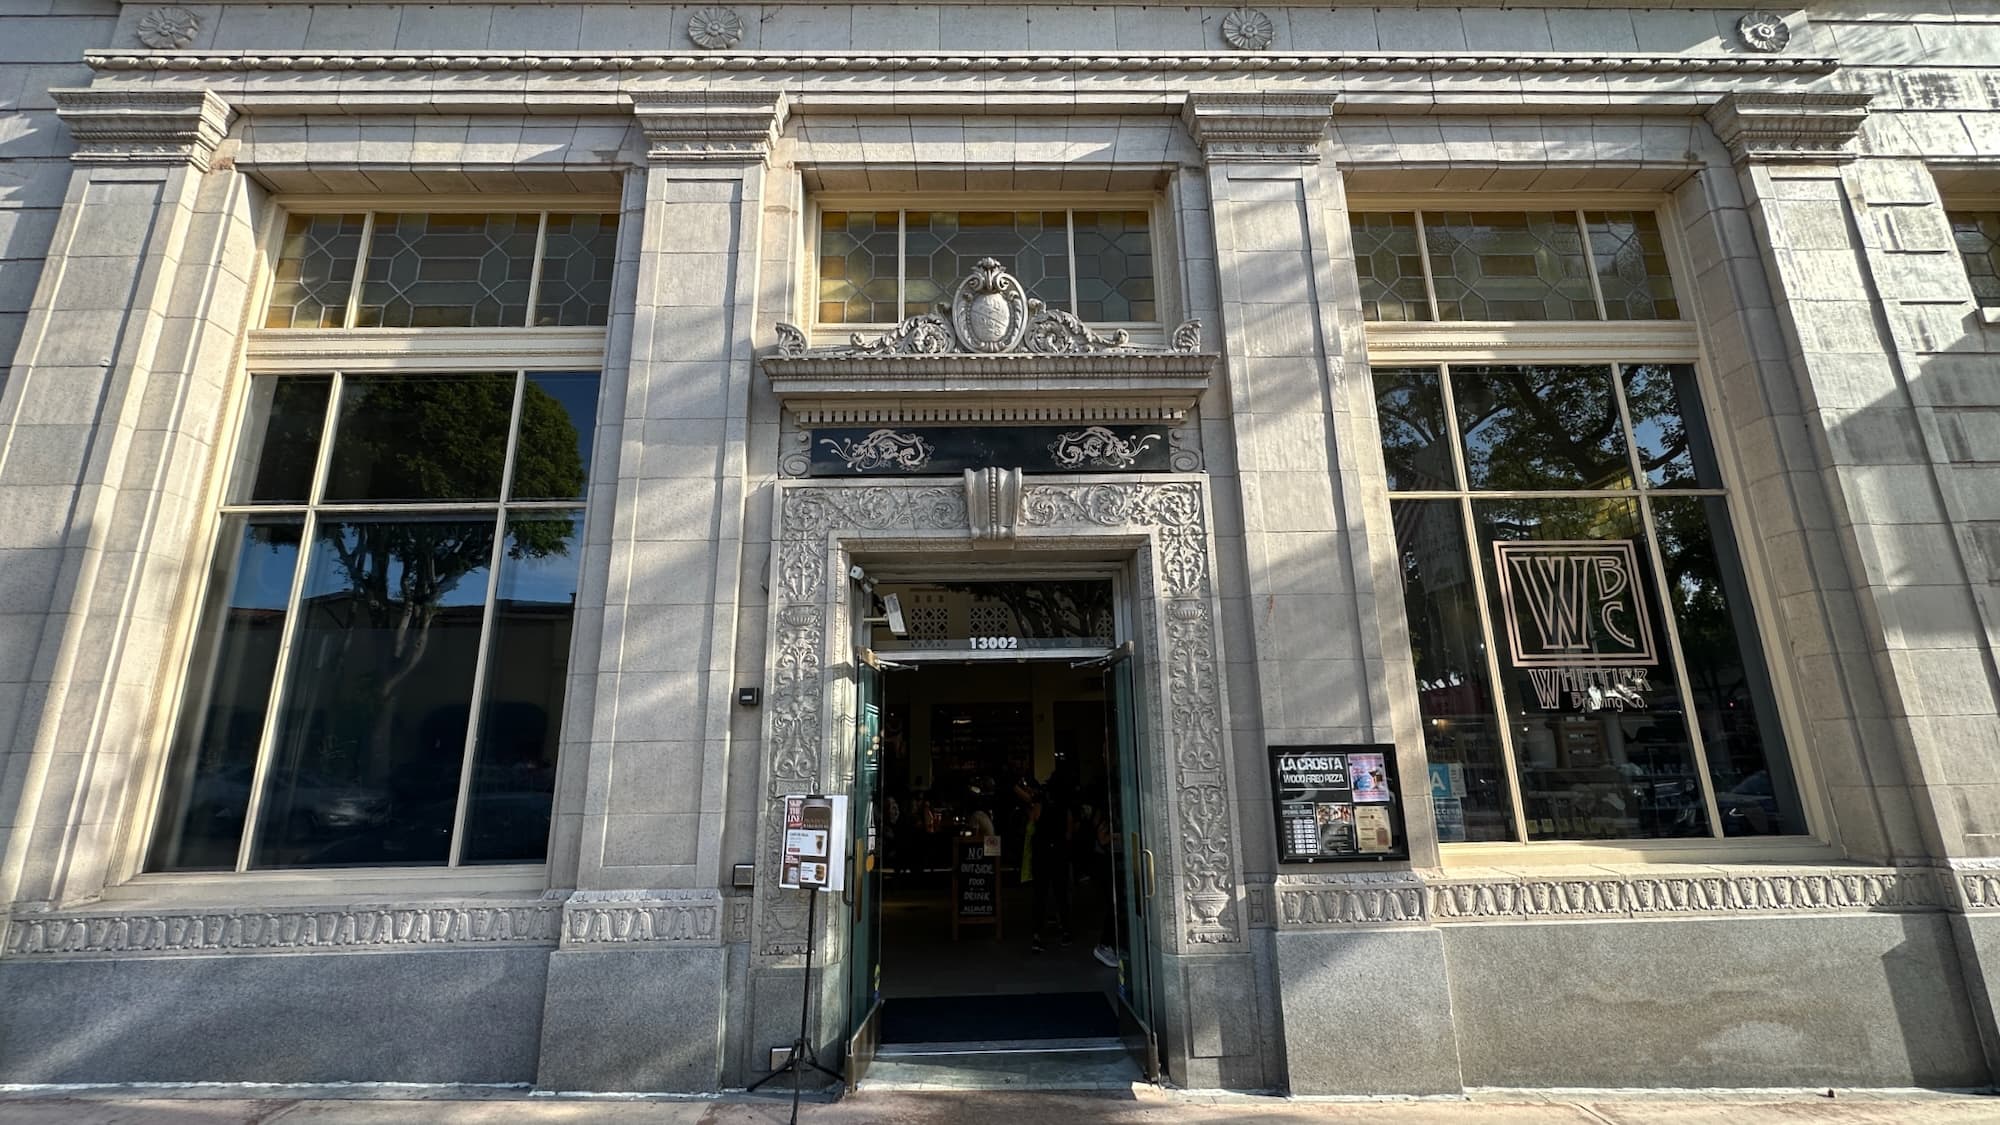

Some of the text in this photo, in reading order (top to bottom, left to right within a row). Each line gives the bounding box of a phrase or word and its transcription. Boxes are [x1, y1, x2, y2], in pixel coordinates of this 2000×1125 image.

[969, 637, 1018, 649] 13002
[1528, 668, 1653, 709] WHITTIER
[1280, 757, 1344, 771] LA CROSTA
[1283, 773, 1344, 783] WOOD FIRED PIZZA
[1430, 771, 1447, 791] A
[968, 847, 984, 858] NO
[961, 863, 994, 874] OUTSIDE
[968, 877, 985, 886] FOOD
[963, 891, 991, 901] DRINK
